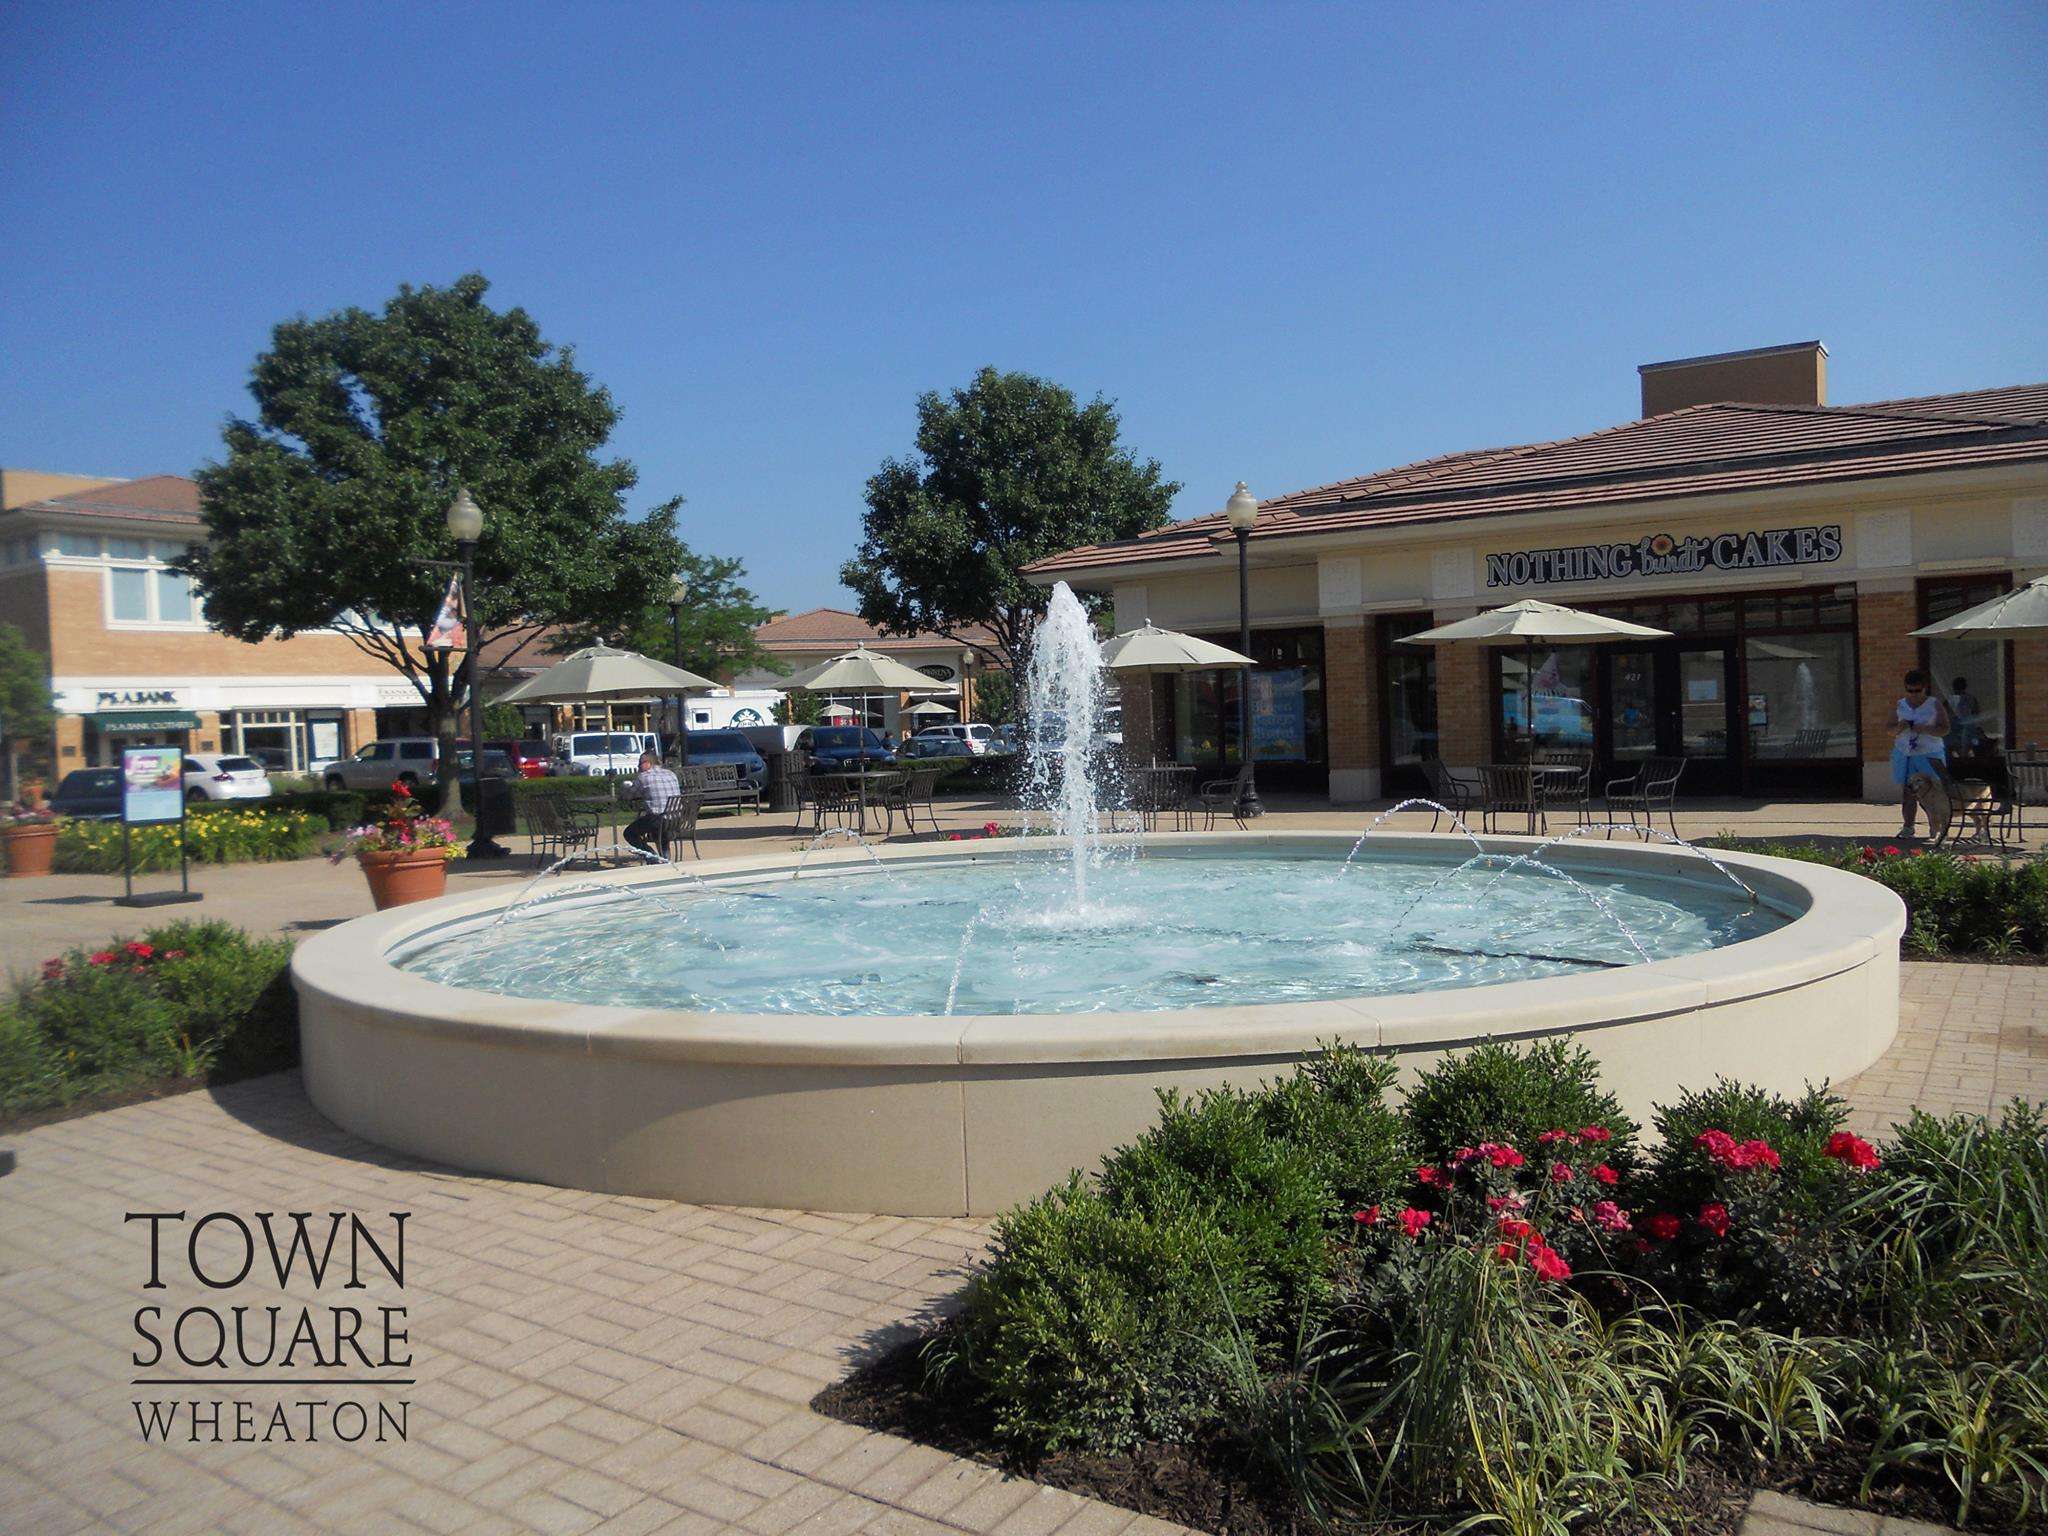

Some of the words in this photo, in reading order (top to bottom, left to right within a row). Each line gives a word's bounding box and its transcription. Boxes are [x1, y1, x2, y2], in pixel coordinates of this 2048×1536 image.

[1487, 543, 1633, 587] NOTHING
[1636, 535, 1711, 575] bundt
[1711, 526, 1842, 570] CAKES
